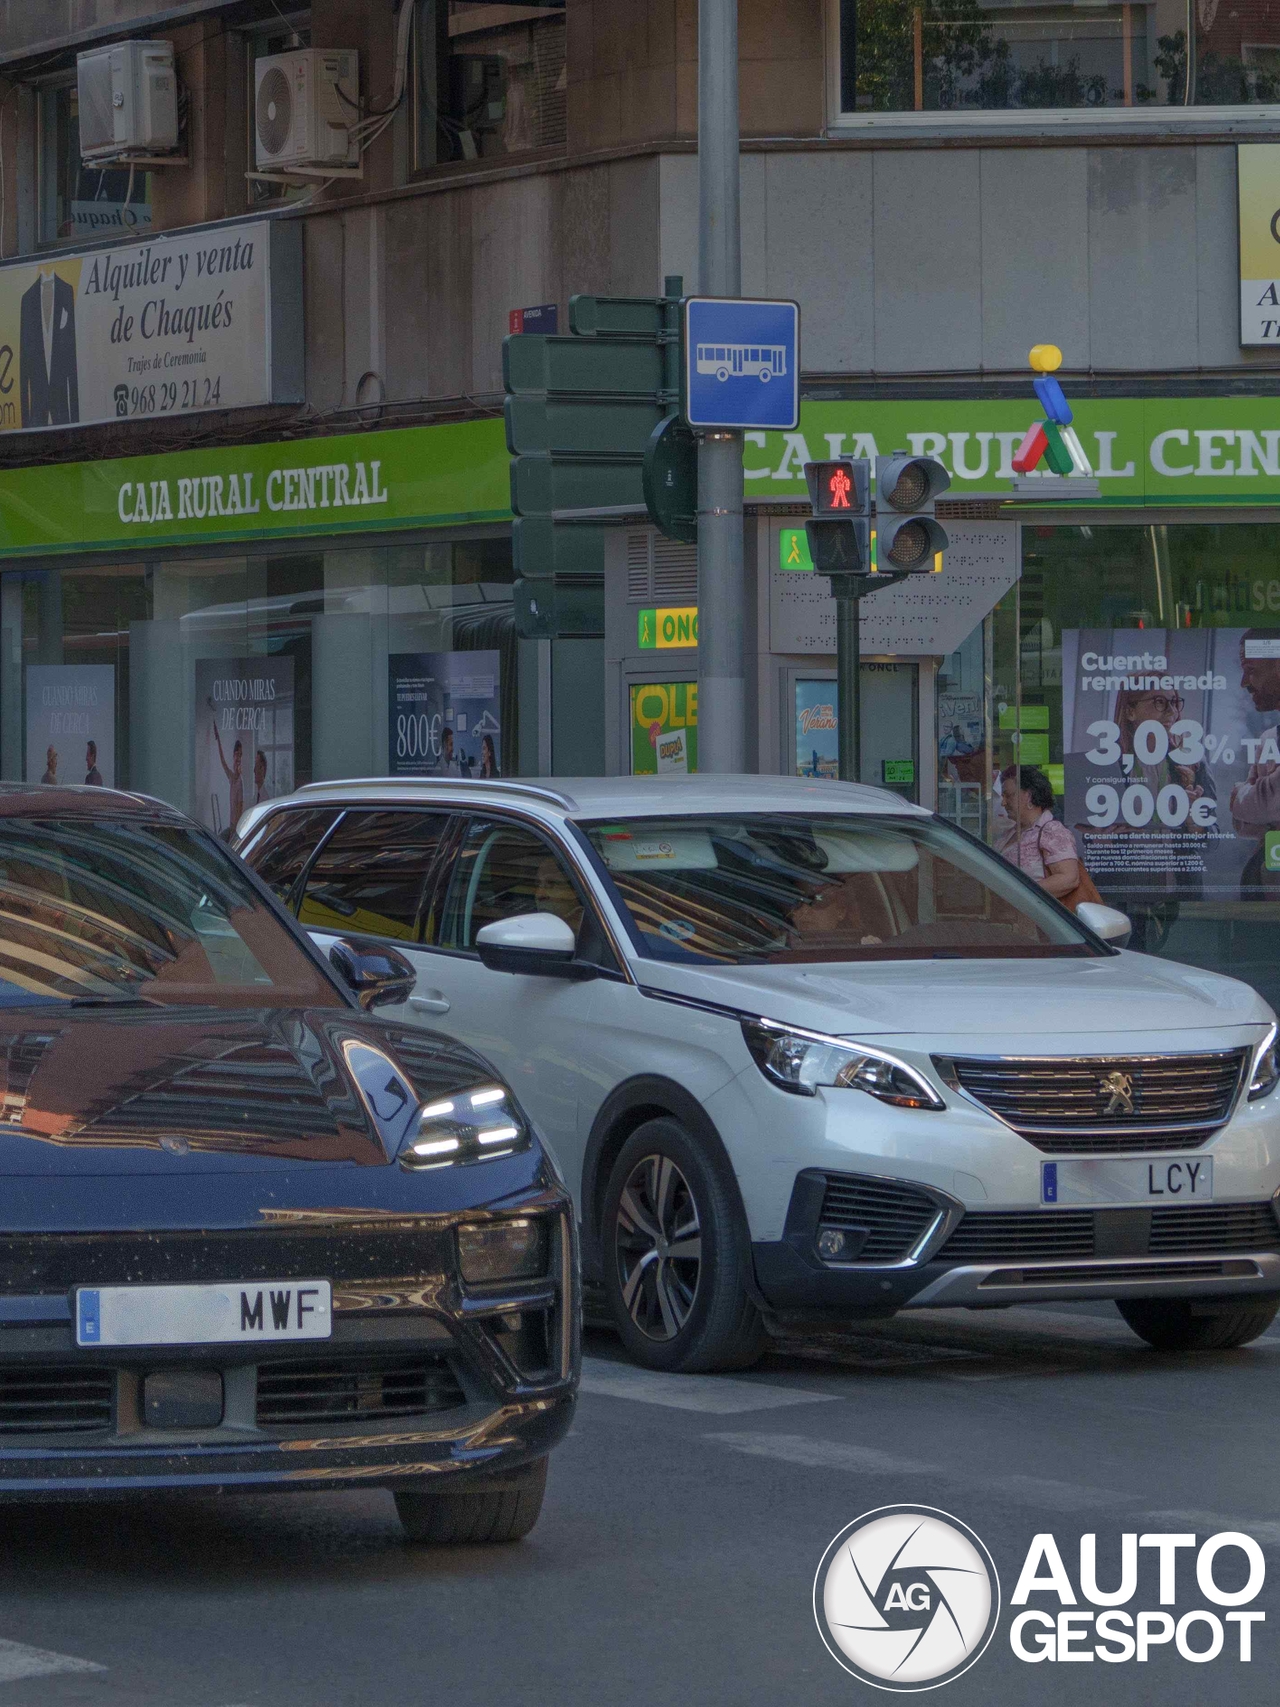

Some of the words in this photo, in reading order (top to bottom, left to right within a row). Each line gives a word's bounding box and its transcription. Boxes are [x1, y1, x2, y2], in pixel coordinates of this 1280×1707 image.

[85, 248, 172, 302] Alquiler
[176, 253, 189, 291] y
[196, 237, 255, 276] venta
[110, 305, 133, 343] de
[140, 290, 233, 344] Chaqués
[524, 308, 542, 319] AVENIDA
[127, 355, 152, 375] Trajes
[153, 353, 162, 369] de
[164, 348, 207, 370] Ceremonia
[131, 384, 156, 415] 968
[160, 381, 177, 413] 29
[181, 379, 198, 409] 21
[203, 375, 221, 406] 24
[907, 432, 1135, 480] RURL
[119, 480, 174, 524] CAJA
[178, 472, 259, 519] RURAL
[267, 461, 387, 511] CENTRAL
[868, 663, 898, 672] ONCE
[1081, 652, 1167, 671] Cuenta
[213, 679, 247, 702] CUANDO
[248, 679, 275, 700] MIRAS
[1082, 671, 1227, 691] remunerada
[222, 707, 235, 730] DE
[237, 706, 267, 730] CERCA
[799, 705, 838, 736] Verano
[397, 713, 442, 758] 800€
[1085, 776, 1090, 784] Y
[1091, 776, 1126, 785] consigue
[1126, 776, 1148, 784] hasta
[1085, 784, 1218, 828] 900€
[1129, 832, 1150, 840] darte
[1183, 832, 1207, 841] mejor
[1048, 1187, 1053, 1196] E
[1148, 1163, 1201, 1195] LCY
[85, 1322, 94, 1334] E
[240, 1289, 319, 1331] MWF
